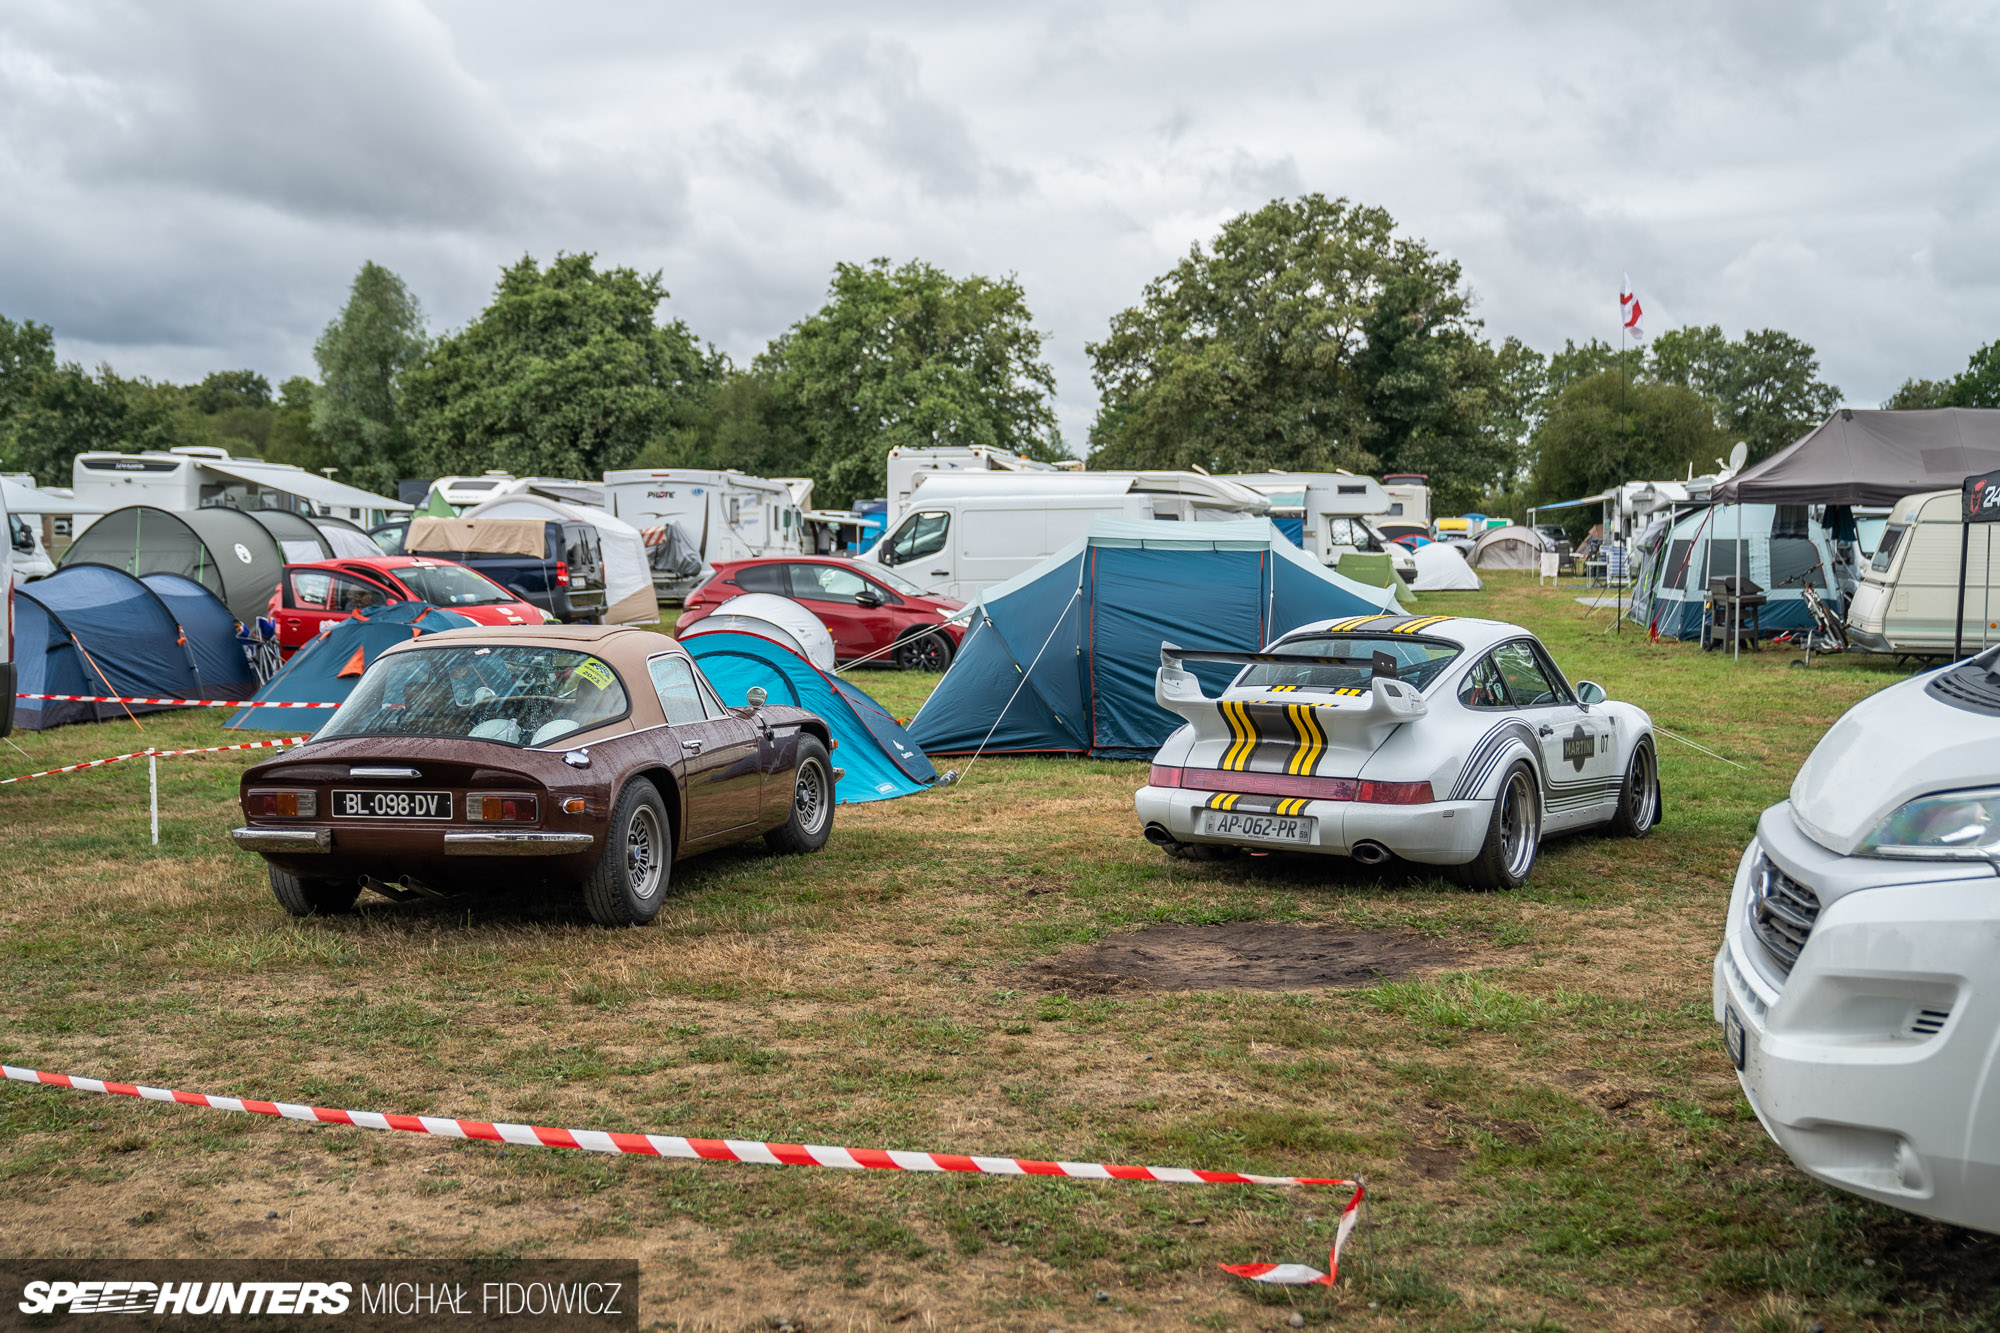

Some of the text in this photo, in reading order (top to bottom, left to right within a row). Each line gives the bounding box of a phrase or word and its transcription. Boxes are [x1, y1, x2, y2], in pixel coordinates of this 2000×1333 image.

[1983, 485, 2000, 508] 24
[1565, 739, 1593, 757] MARTINI
[1600, 733, 1609, 754] 07
[1193, 772, 1343, 794] PORSCHE
[345, 793, 439, 816] BL-098-DV
[1217, 815, 1298, 839] AP-062-PR
[1299, 830, 1309, 839] 59
